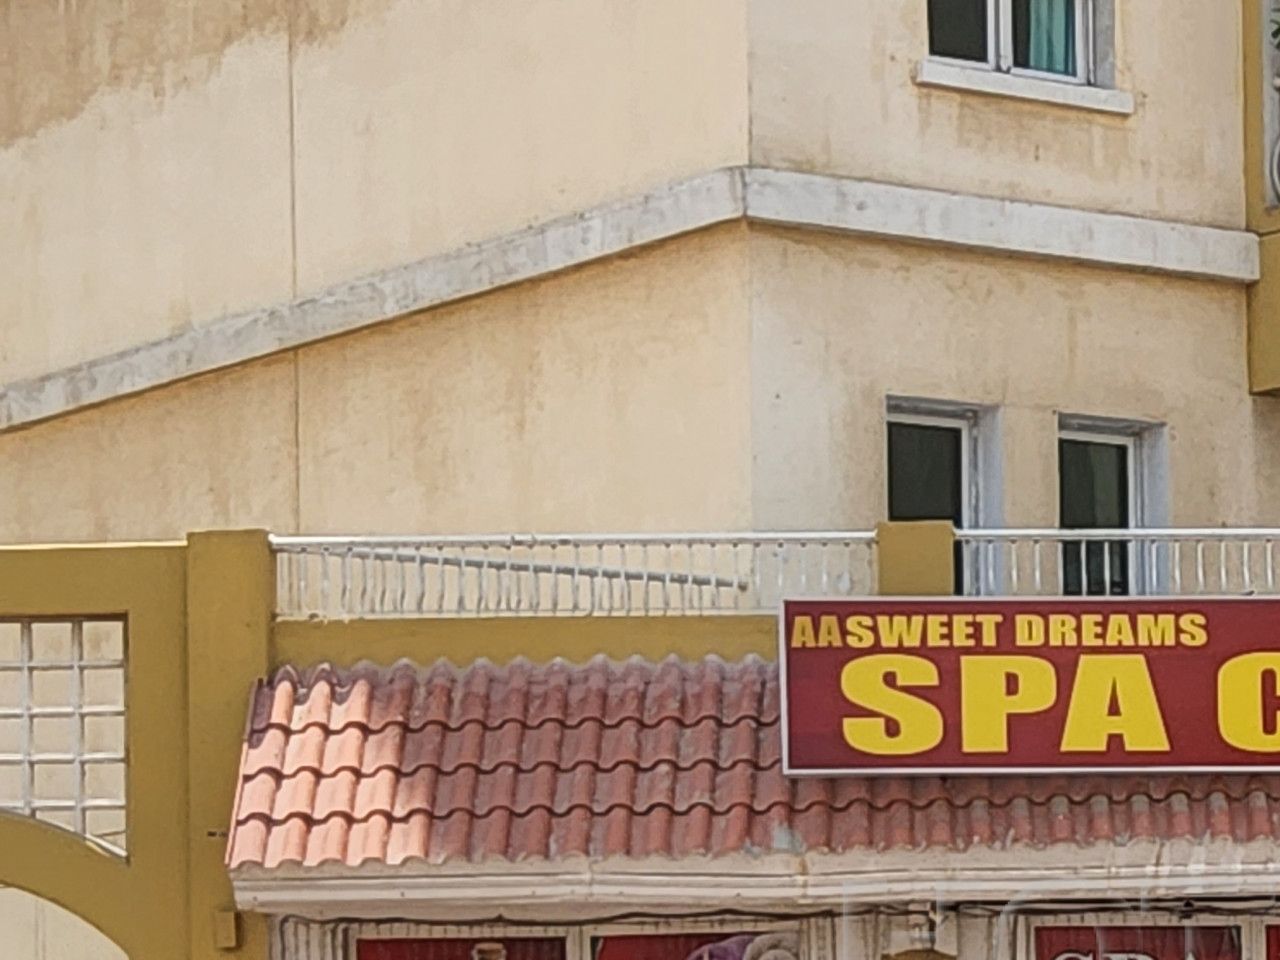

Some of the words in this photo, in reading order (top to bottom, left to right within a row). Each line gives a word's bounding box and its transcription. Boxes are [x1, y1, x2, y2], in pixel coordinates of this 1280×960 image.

[791, 614, 1003, 649] AASWEET
[1014, 613, 1209, 647] DREAMS
[840, 652, 1171, 755] SPA
